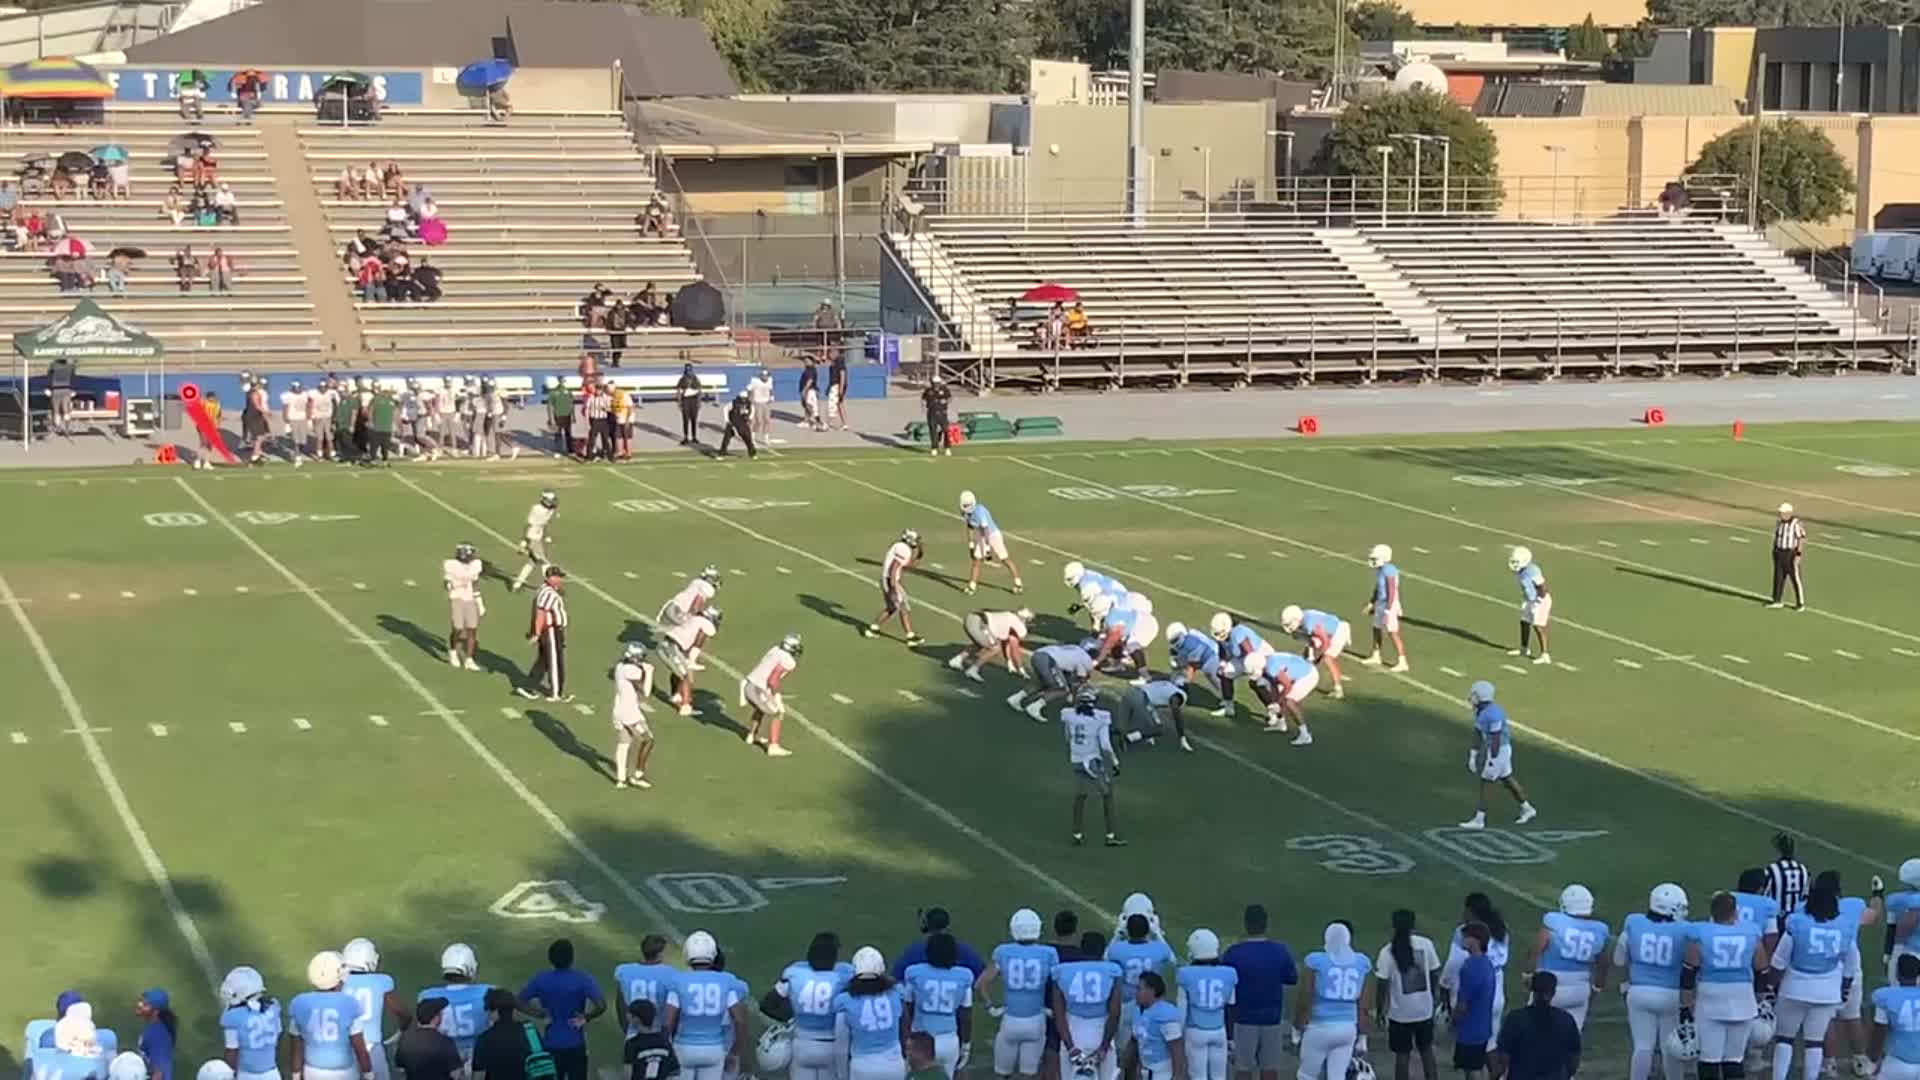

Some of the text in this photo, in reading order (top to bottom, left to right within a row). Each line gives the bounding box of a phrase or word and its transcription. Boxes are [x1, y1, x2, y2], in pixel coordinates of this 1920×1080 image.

[1650, 409, 1663, 423] G
[1561, 927, 1595, 961] 56
[1640, 933, 1673, 966] 60
[1712, 935, 1747, 968] 57
[687, 983, 721, 1016] 39
[800, 979, 833, 1016] 48
[922, 979, 957, 1013] 35
[1069, 971, 1101, 1003] 43
[1197, 979, 1224, 1009] 16
[1327, 967, 1360, 1000] 36
[307, 1007, 341, 1041] 46
[859, 998, 893, 1031] 49
